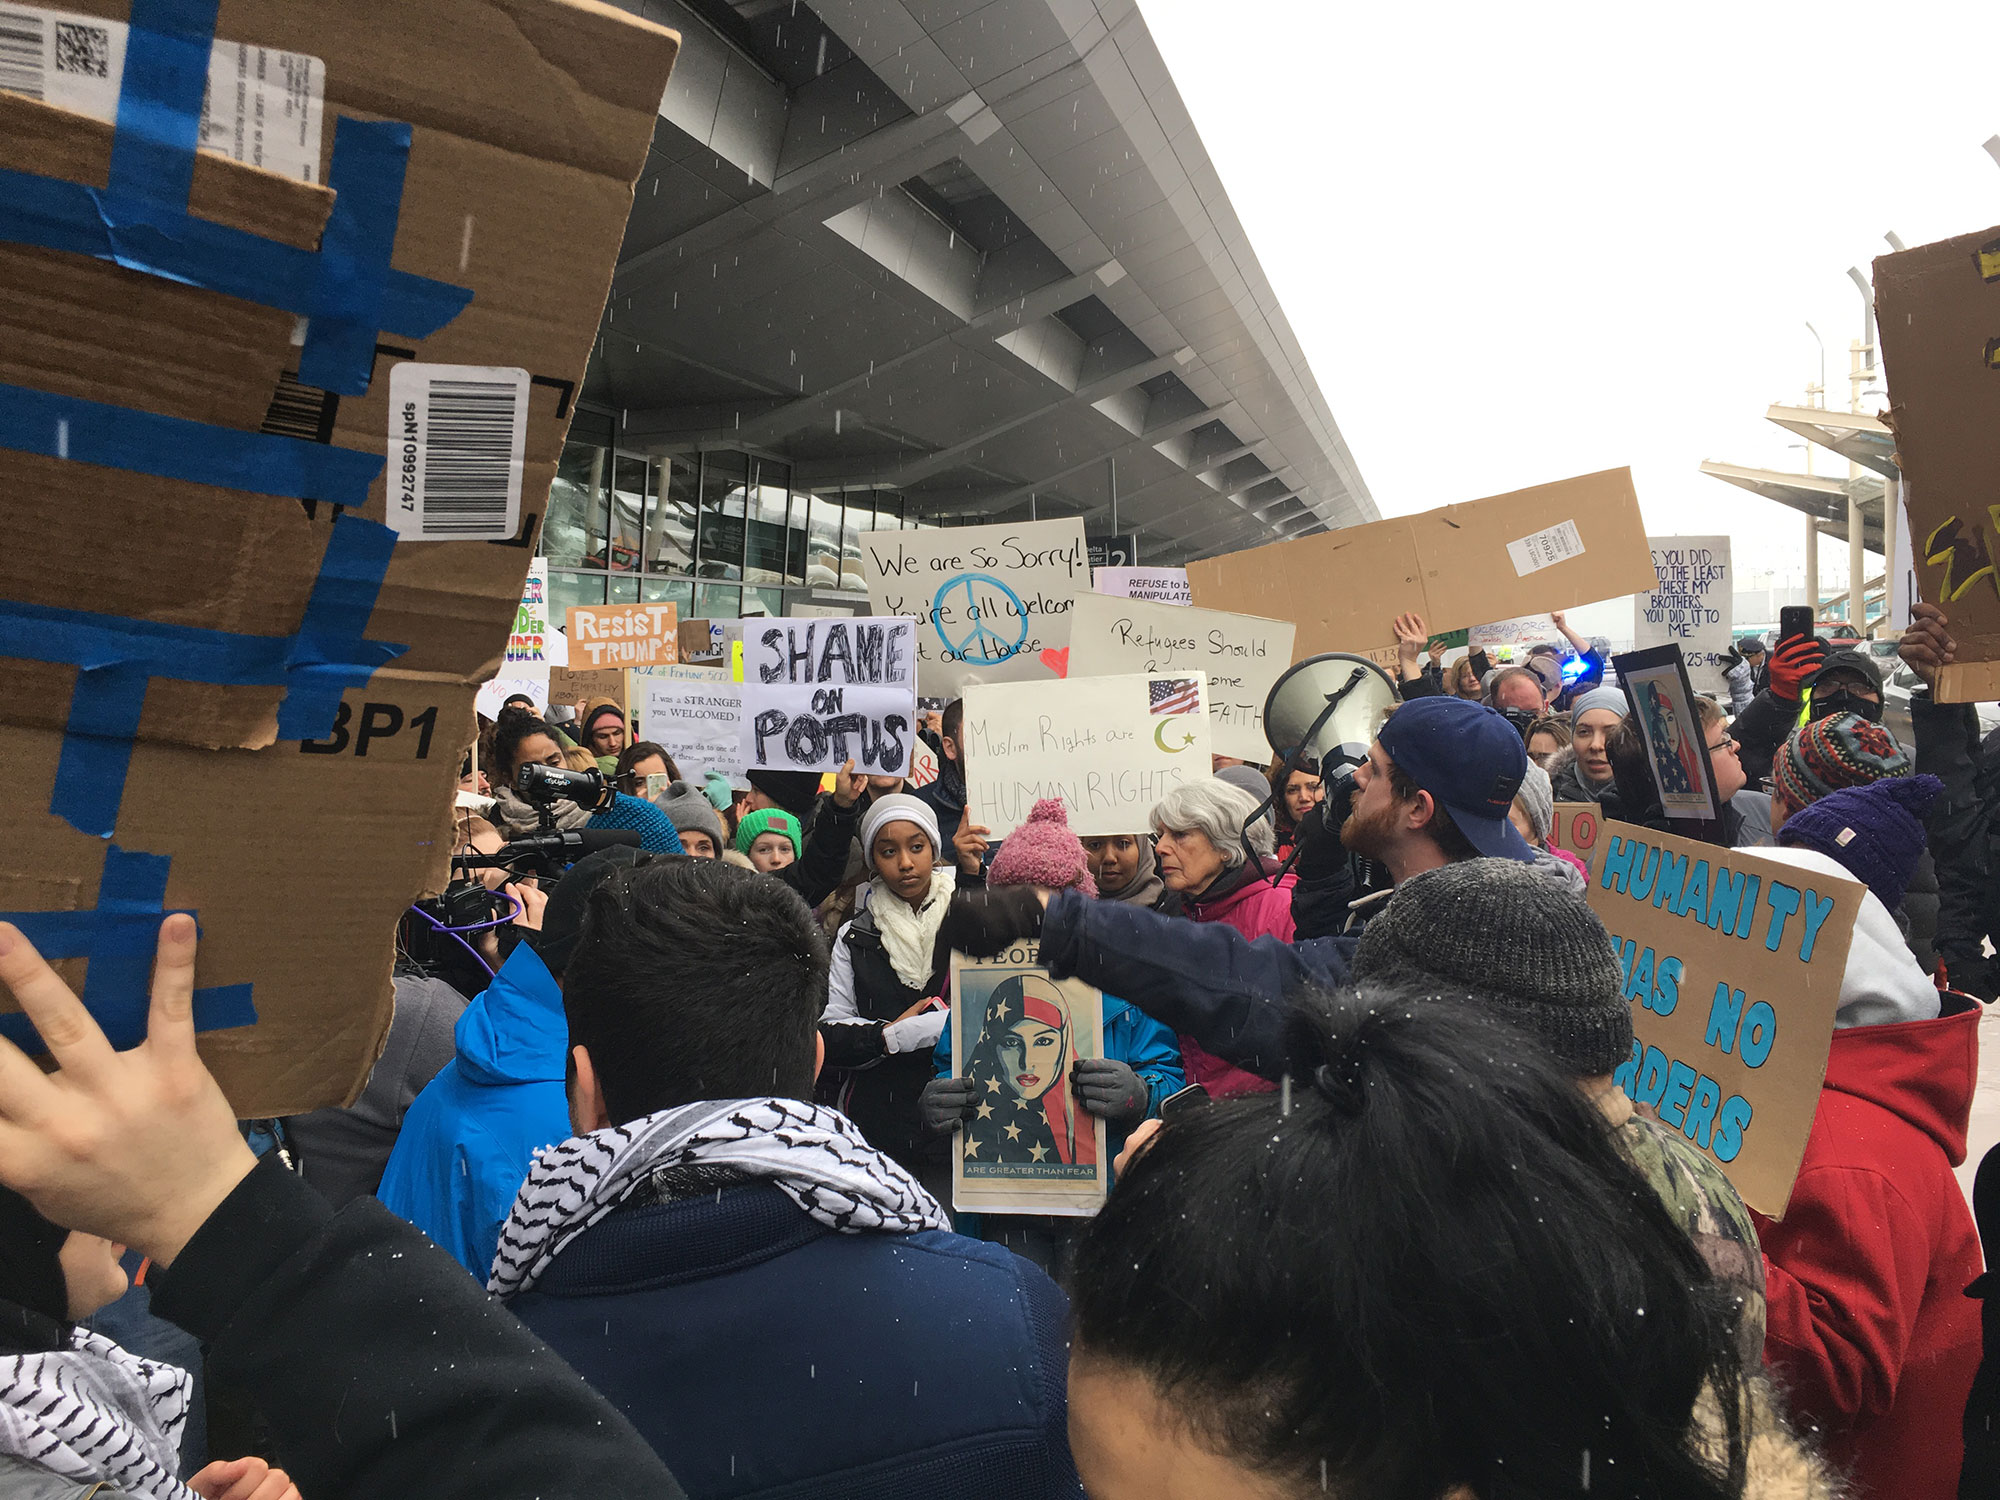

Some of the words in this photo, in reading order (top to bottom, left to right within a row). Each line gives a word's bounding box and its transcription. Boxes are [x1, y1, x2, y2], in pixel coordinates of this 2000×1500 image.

[401, 402, 418, 512] spN10992747
[1539, 534, 1556, 562] 70925
[869, 544, 919, 577] We
[930, 556, 965, 572] are
[970, 547, 998, 569] So
[1001, 536, 1083, 578] Sorry!
[1111, 550, 1127, 567] 2
[1661, 550, 1684, 566] YOU
[1689, 549, 1712, 566] DID
[1671, 566, 1690, 580] THE
[1694, 565, 1726, 580] LEAST
[1129, 579, 1168, 589] REFUSE
[1170, 581, 1181, 589] to
[1183, 581, 1190, 589] b
[1659, 581, 1689, 594] THESE
[1692, 581, 1712, 594] MY
[967, 596, 998, 621] all
[1643, 609, 1664, 623] YOU
[1669, 609, 1685, 623] DID
[1691, 609, 1703, 623] IT
[1704, 609, 1720, 623] TO
[511, 605, 545, 634] DER
[1111, 618, 1196, 664] Refugees
[1208, 629, 1266, 657] Should
[584, 638, 662, 664] TRUMP
[759, 622, 910, 685] SHAME
[941, 647, 974, 663] our
[1687, 652, 1721, 667] 25:40
[511, 679, 544, 699] ATE
[1207, 677, 1245, 688] ome
[684, 696, 742, 708] STRANGER
[811, 687, 845, 714] ON
[652, 709, 666, 718] you
[670, 708, 735, 721] WELCOMED
[754, 708, 909, 773] POTUS
[970, 719, 1029, 757] Muslim
[1038, 714, 1097, 753] Rights
[1105, 729, 1134, 742] are
[680, 744, 693, 752] you
[695, 742, 705, 750] do
[707, 744, 714, 752] to
[729, 745, 738, 753] of
[703, 756, 715, 764] you
[1601, 835, 1834, 962] HUMANITY
[976, 948, 1040, 964] EOP
[1705, 981, 1777, 1068] NO
[989, 1167, 1034, 1175] GREATER
[1067, 1168, 1094, 1176] FEAR
